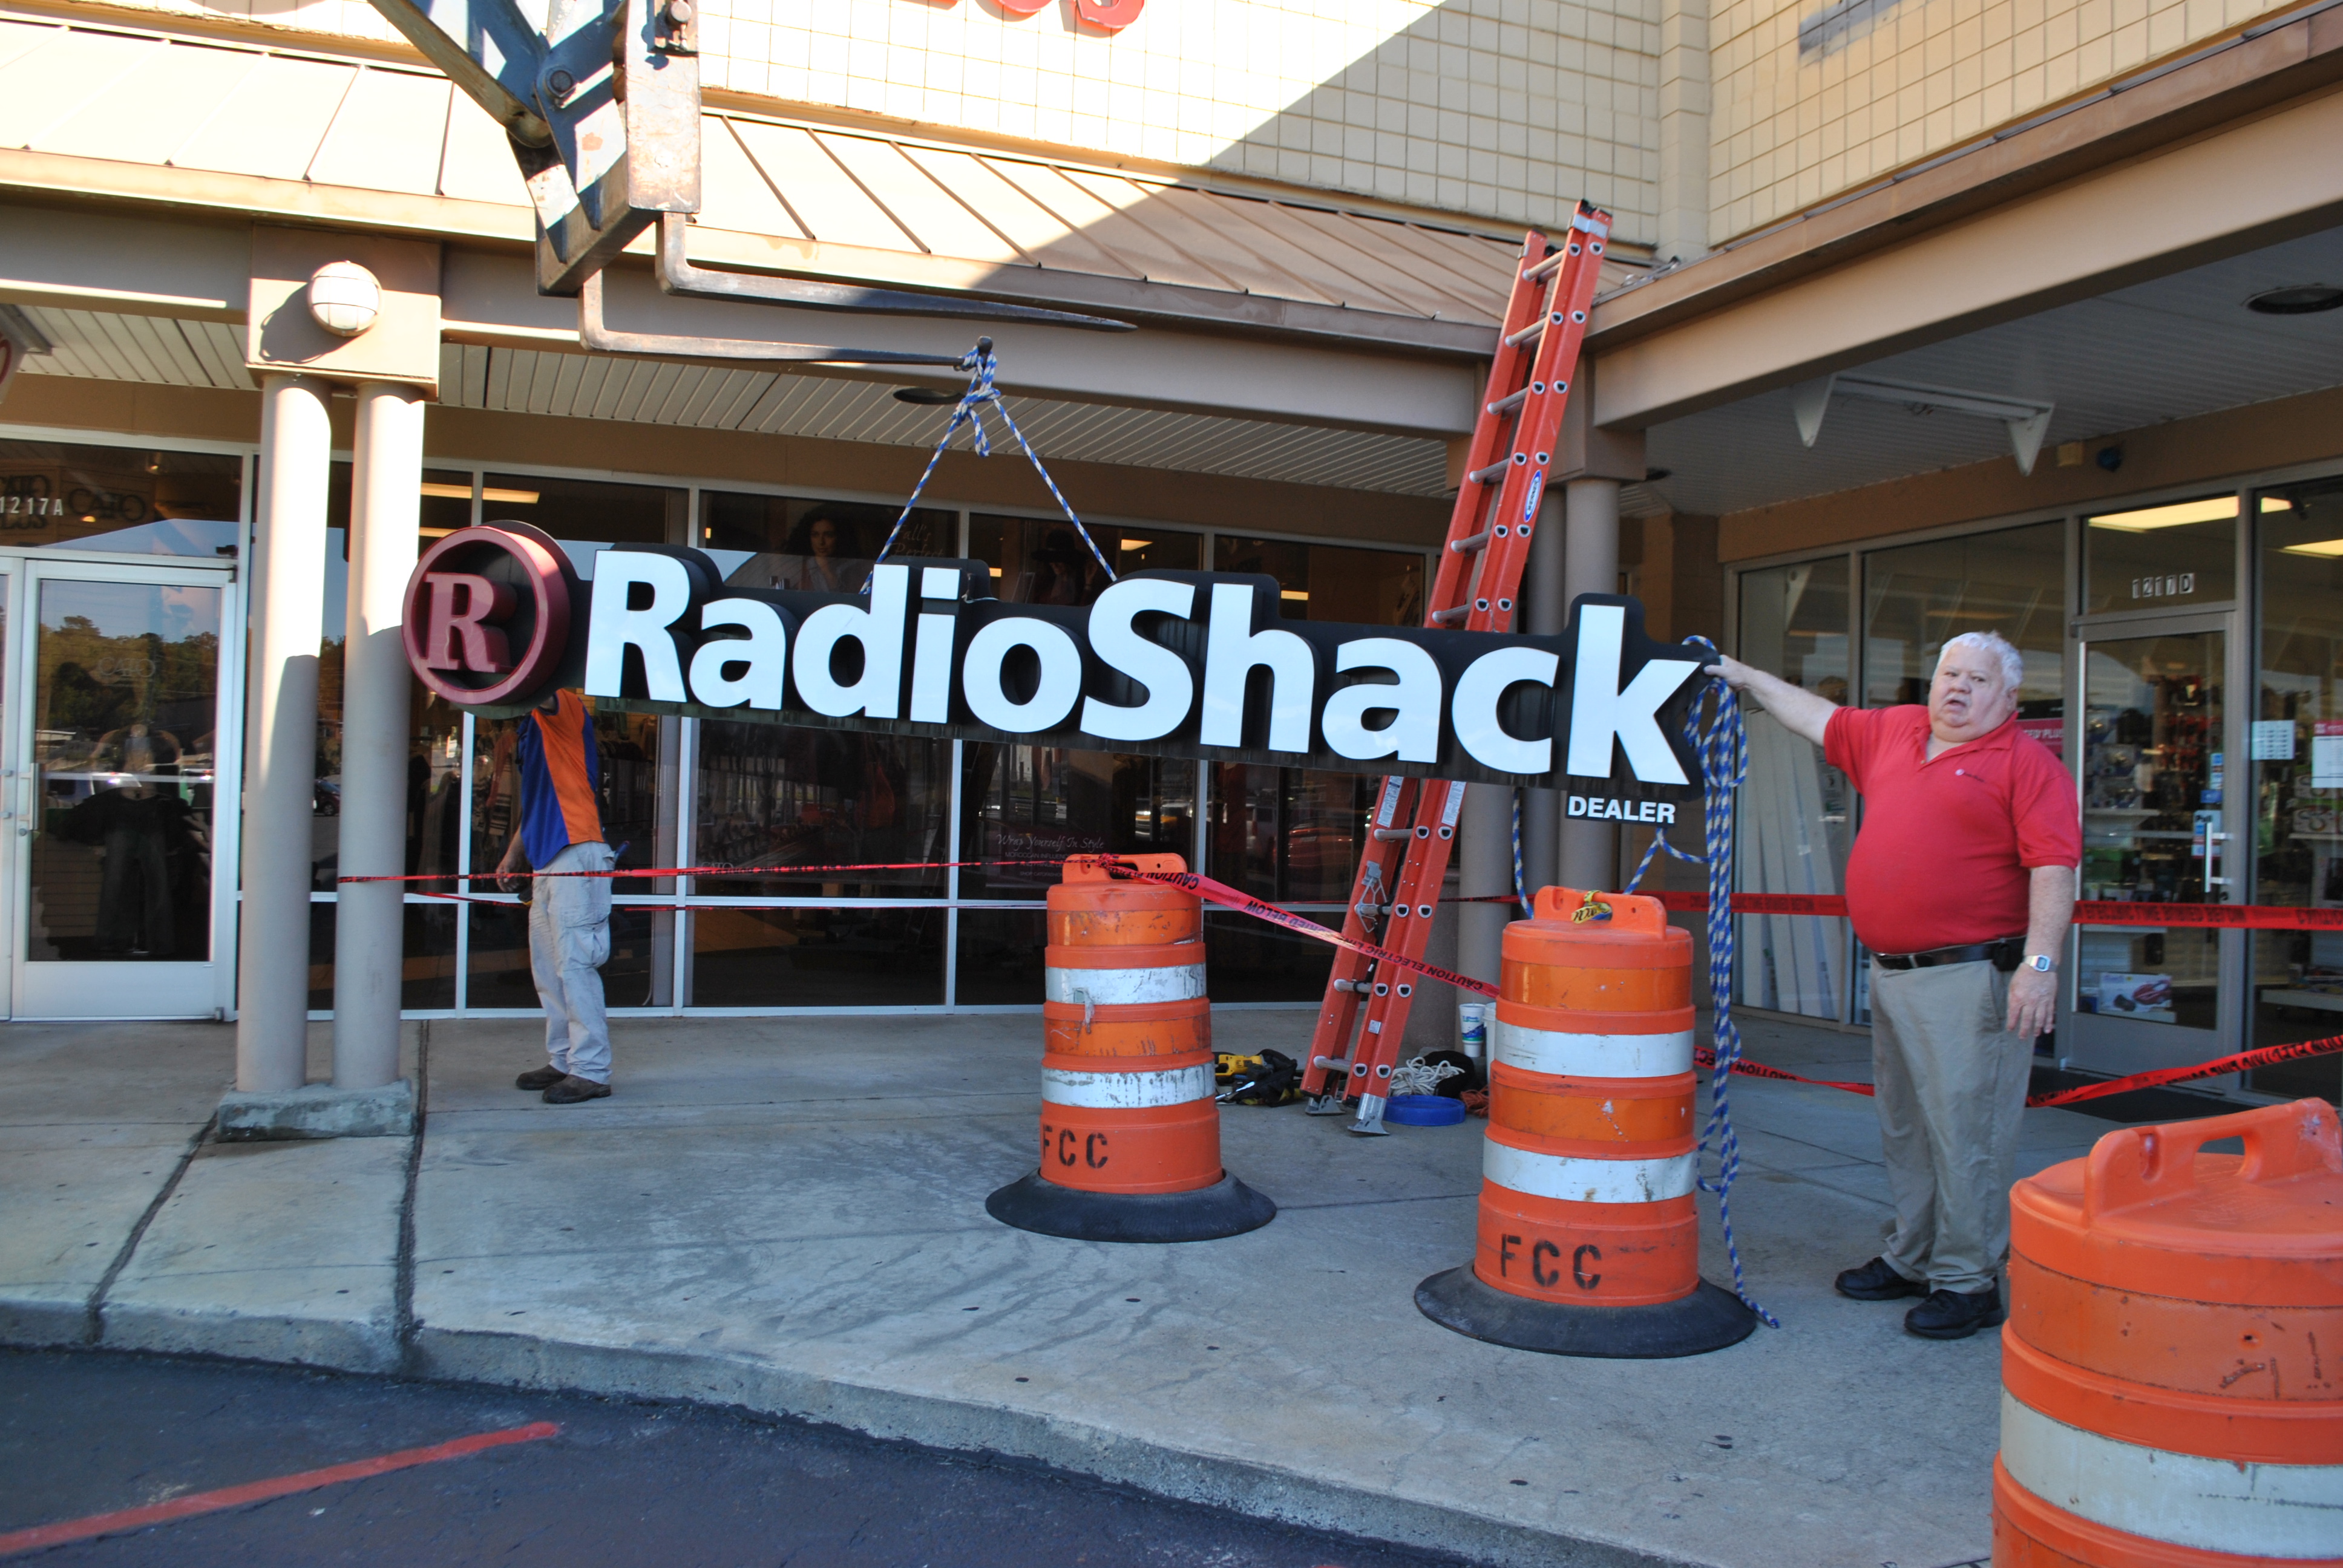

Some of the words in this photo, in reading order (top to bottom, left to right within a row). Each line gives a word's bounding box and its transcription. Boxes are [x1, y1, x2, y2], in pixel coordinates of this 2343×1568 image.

[0, 496, 64, 516] 1217A
[2132, 573, 2194, 598] 1217D
[584, 549, 1700, 785] RadioShack
[1568, 795, 1676, 824] DEALER
[997, 834, 1023, 851] Wrap
[1027, 835, 1066, 852] Yourself
[1066, 837, 1078, 848] In
[1080, 838, 1104, 853] Style
[1245, 900, 1288, 923] BELOW
[1365, 945, 1423, 970] ELECTRIC
[1427, 966, 1483, 991] CAUTION
[1043, 1125, 1108, 1168] FCC
[1501, 1234, 1602, 1289] FCC
